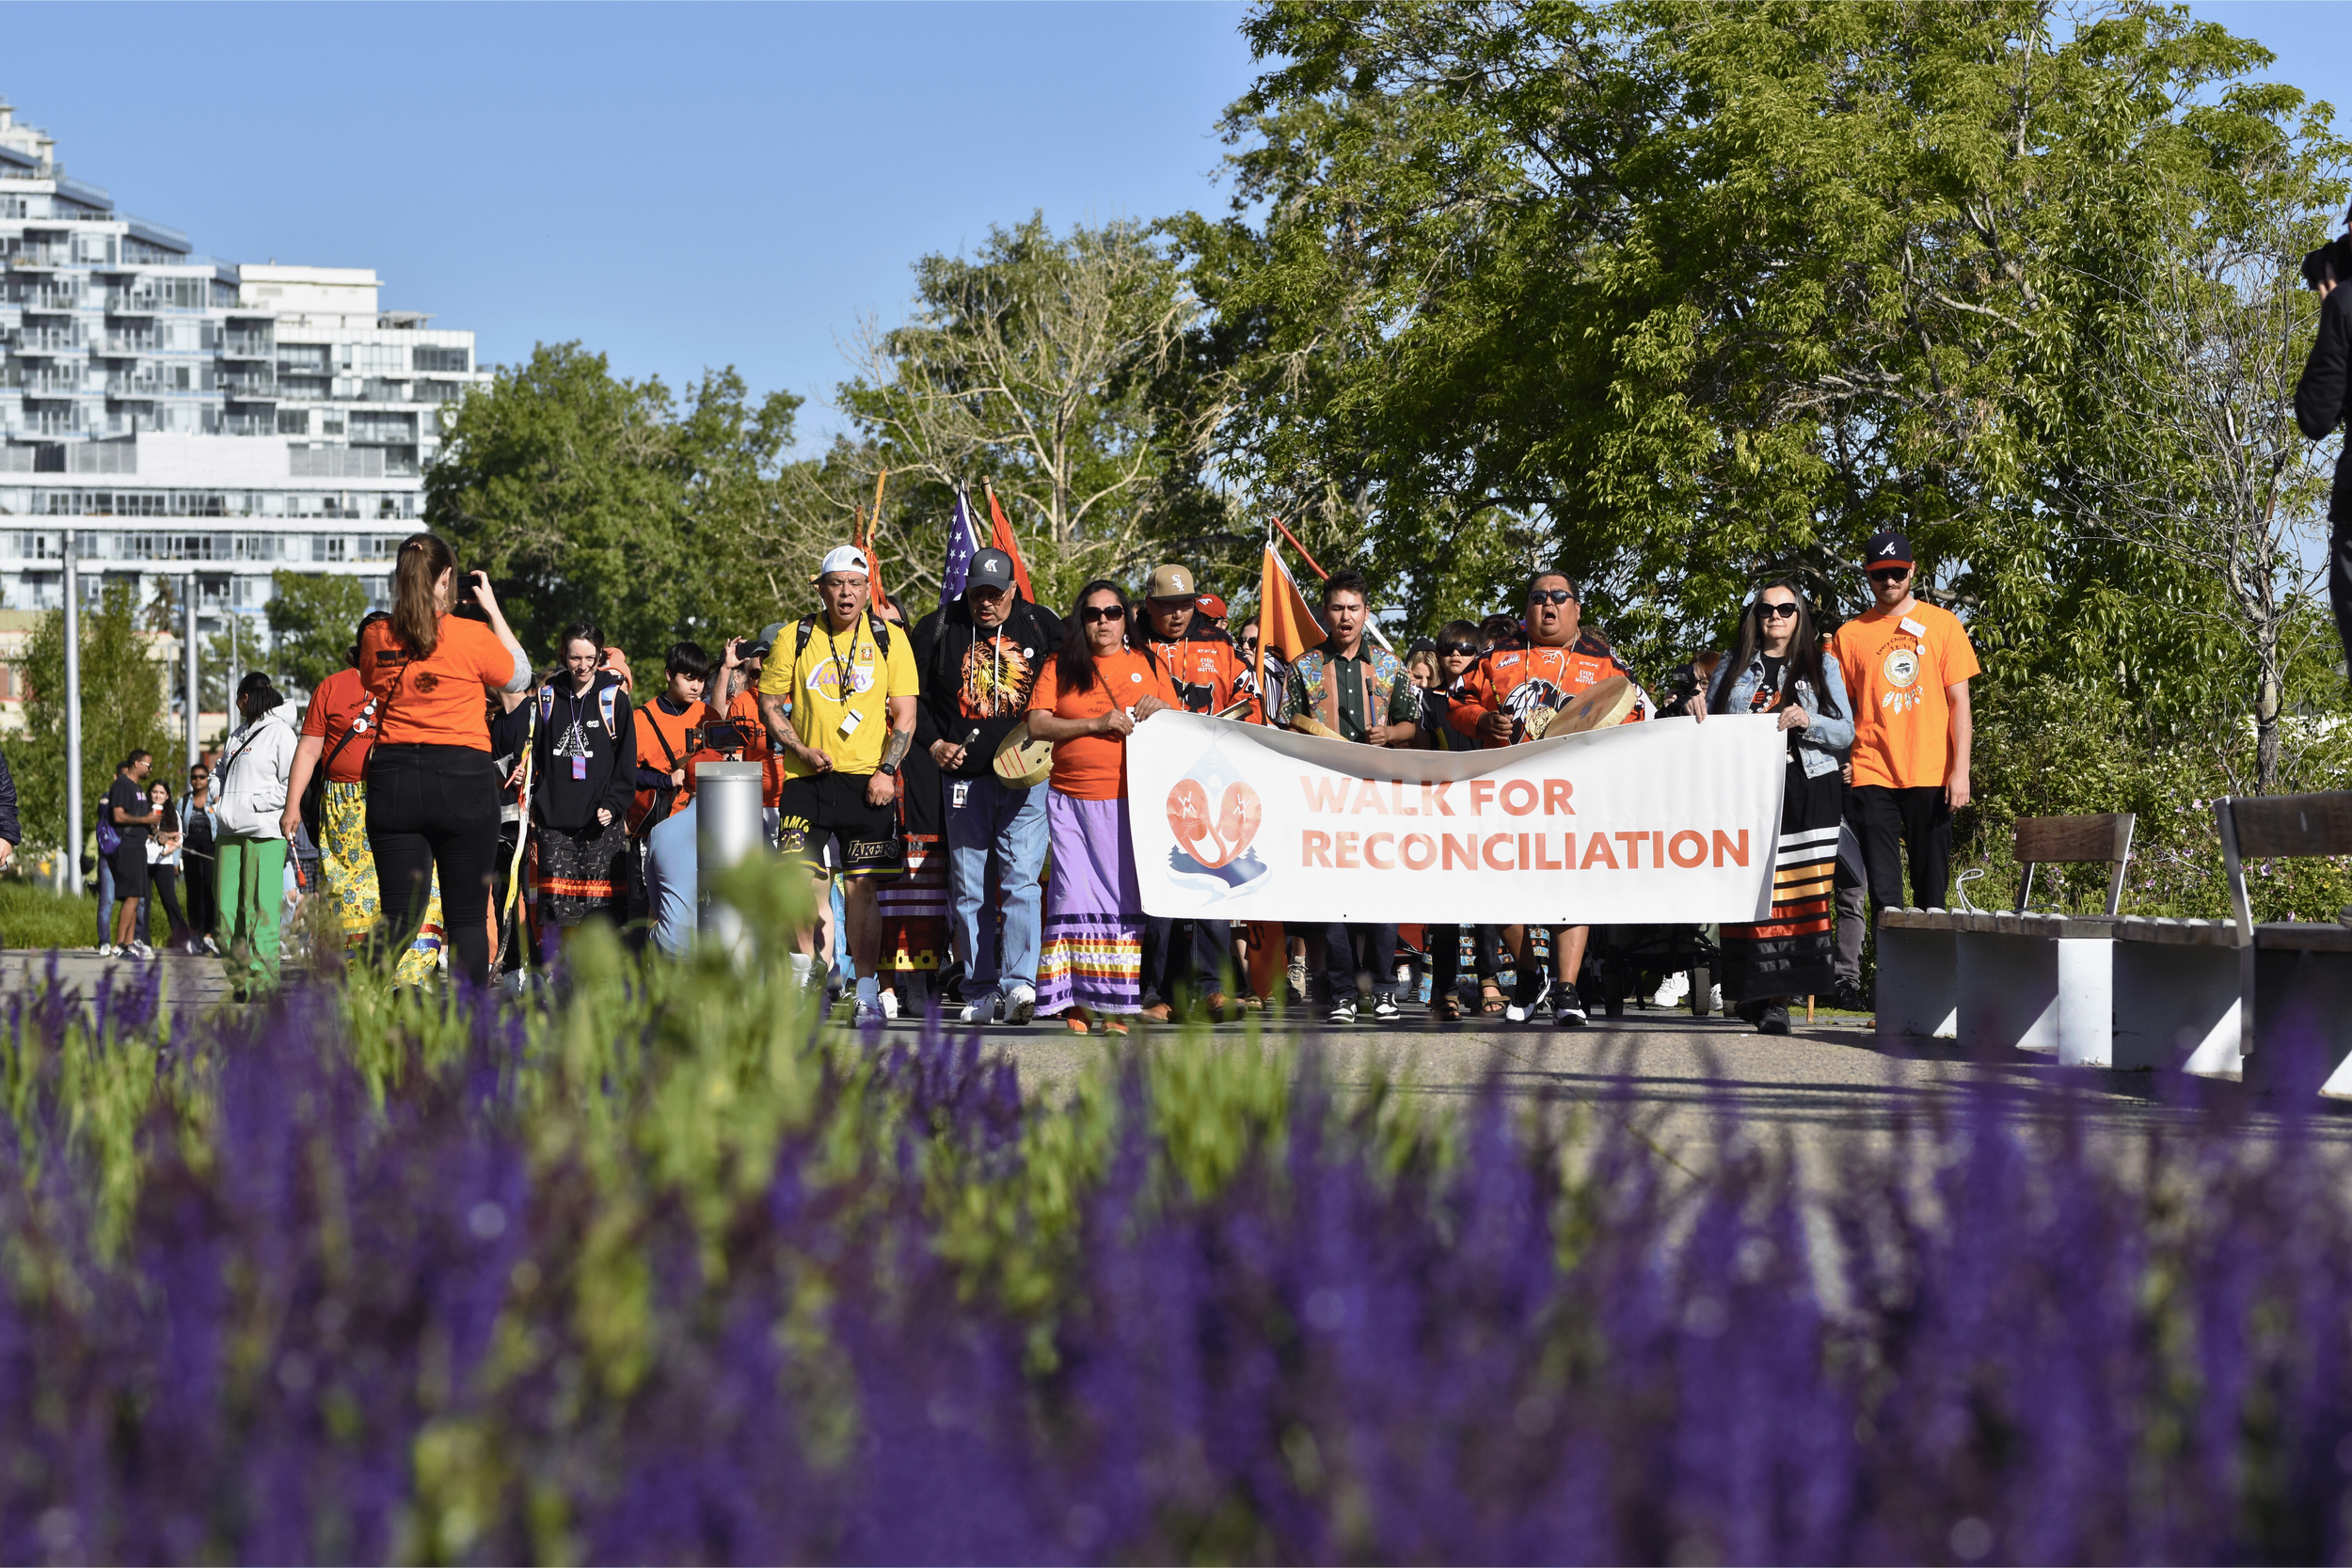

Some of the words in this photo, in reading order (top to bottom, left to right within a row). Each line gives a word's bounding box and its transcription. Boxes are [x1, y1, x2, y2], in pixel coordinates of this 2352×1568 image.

[1879, 541, 1897, 556] A
[1875, 641, 1890, 656] Every
[1500, 656, 1520, 667] WHL
[810, 666, 867, 690] LAKRS
[1299, 776, 1456, 816] WALK
[1470, 779, 1576, 816] FOR
[781, 829, 805, 854] 23
[1302, 830, 1749, 871] RECONCILIATION
